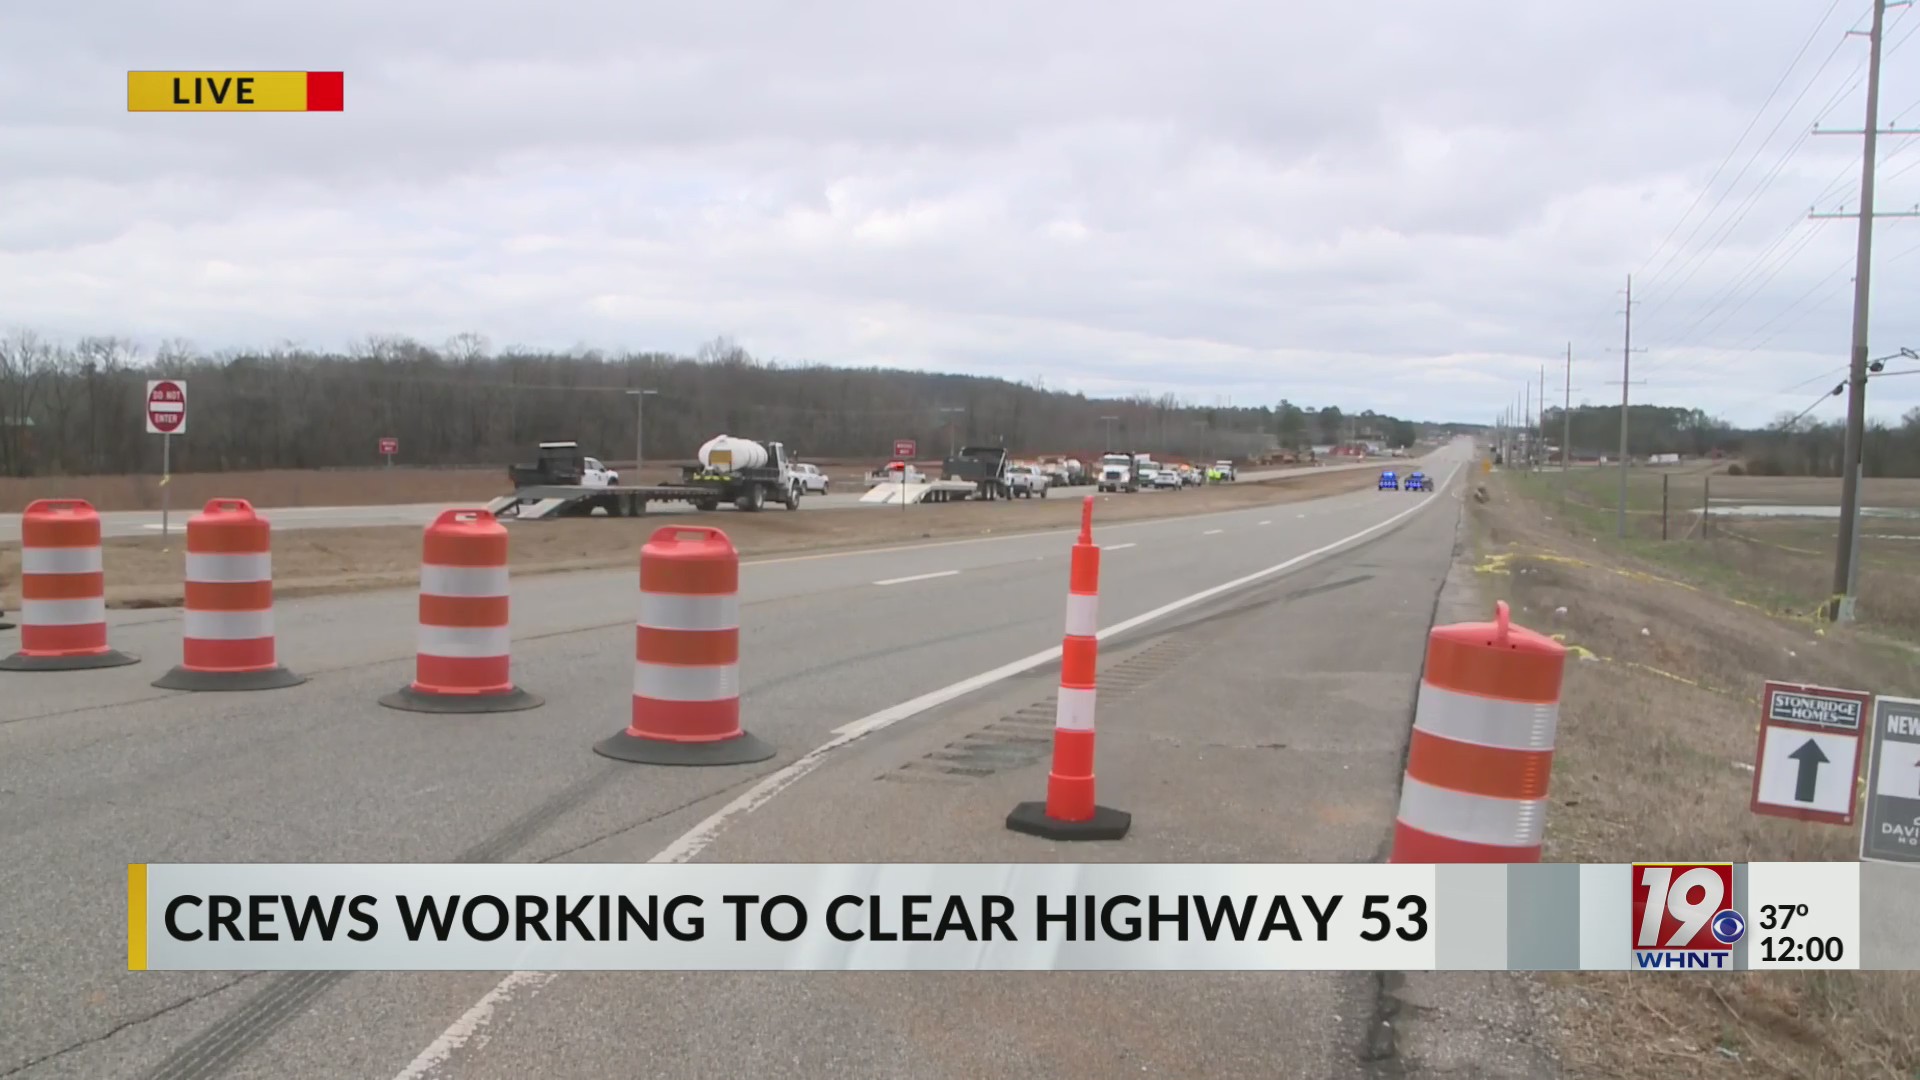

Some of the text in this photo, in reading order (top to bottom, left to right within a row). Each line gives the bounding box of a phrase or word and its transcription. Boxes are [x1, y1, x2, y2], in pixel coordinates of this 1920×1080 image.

[153, 391, 180, 400] DO NOT
[154, 414, 178, 424] ENTER
[1775, 695, 1856, 716] STONERIDGE
[1791, 707, 1839, 723] HOMES
[1887, 715, 1920, 736] NEW
